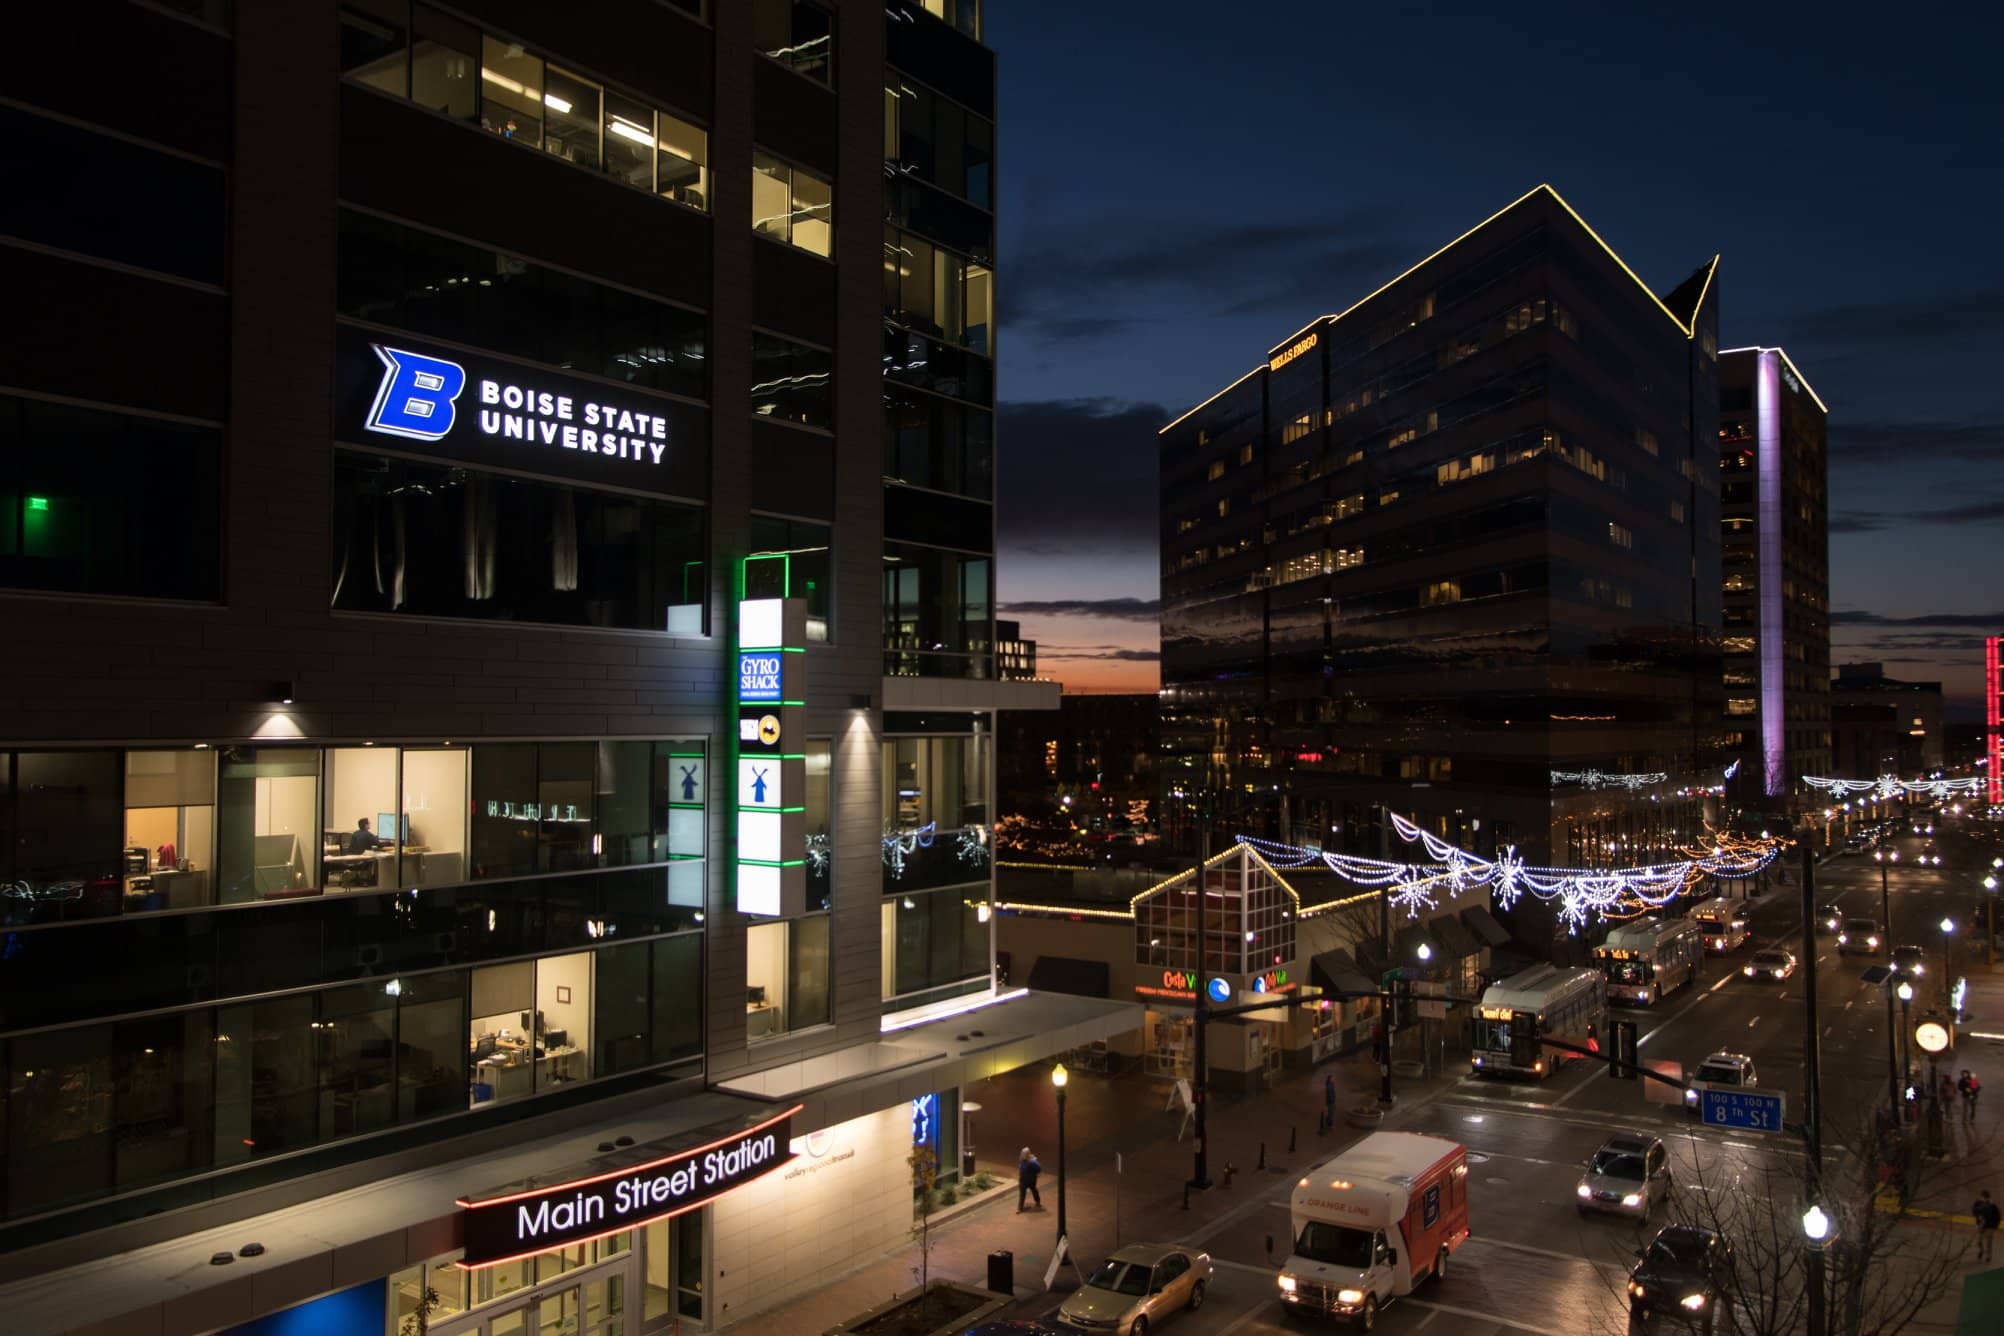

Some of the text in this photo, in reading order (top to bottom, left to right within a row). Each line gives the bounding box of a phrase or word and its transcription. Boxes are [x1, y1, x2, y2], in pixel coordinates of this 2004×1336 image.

[1270, 333, 1318, 371] WELLS FARGO
[479, 379, 667, 439] BOISE STATE
[479, 410, 667, 465] UNIVERSITY
[741, 658, 780, 675] GYRO
[741, 675, 780, 689] SHACK
[1710, 1094, 1728, 1104] 100
[1732, 1096, 1737, 1104] S
[1744, 1097, 1762, 1107] 100
[1750, 1110, 1769, 1127] St
[517, 1133, 776, 1239] Main Street Station
[1307, 1199, 1370, 1217] ORANGE LINE
